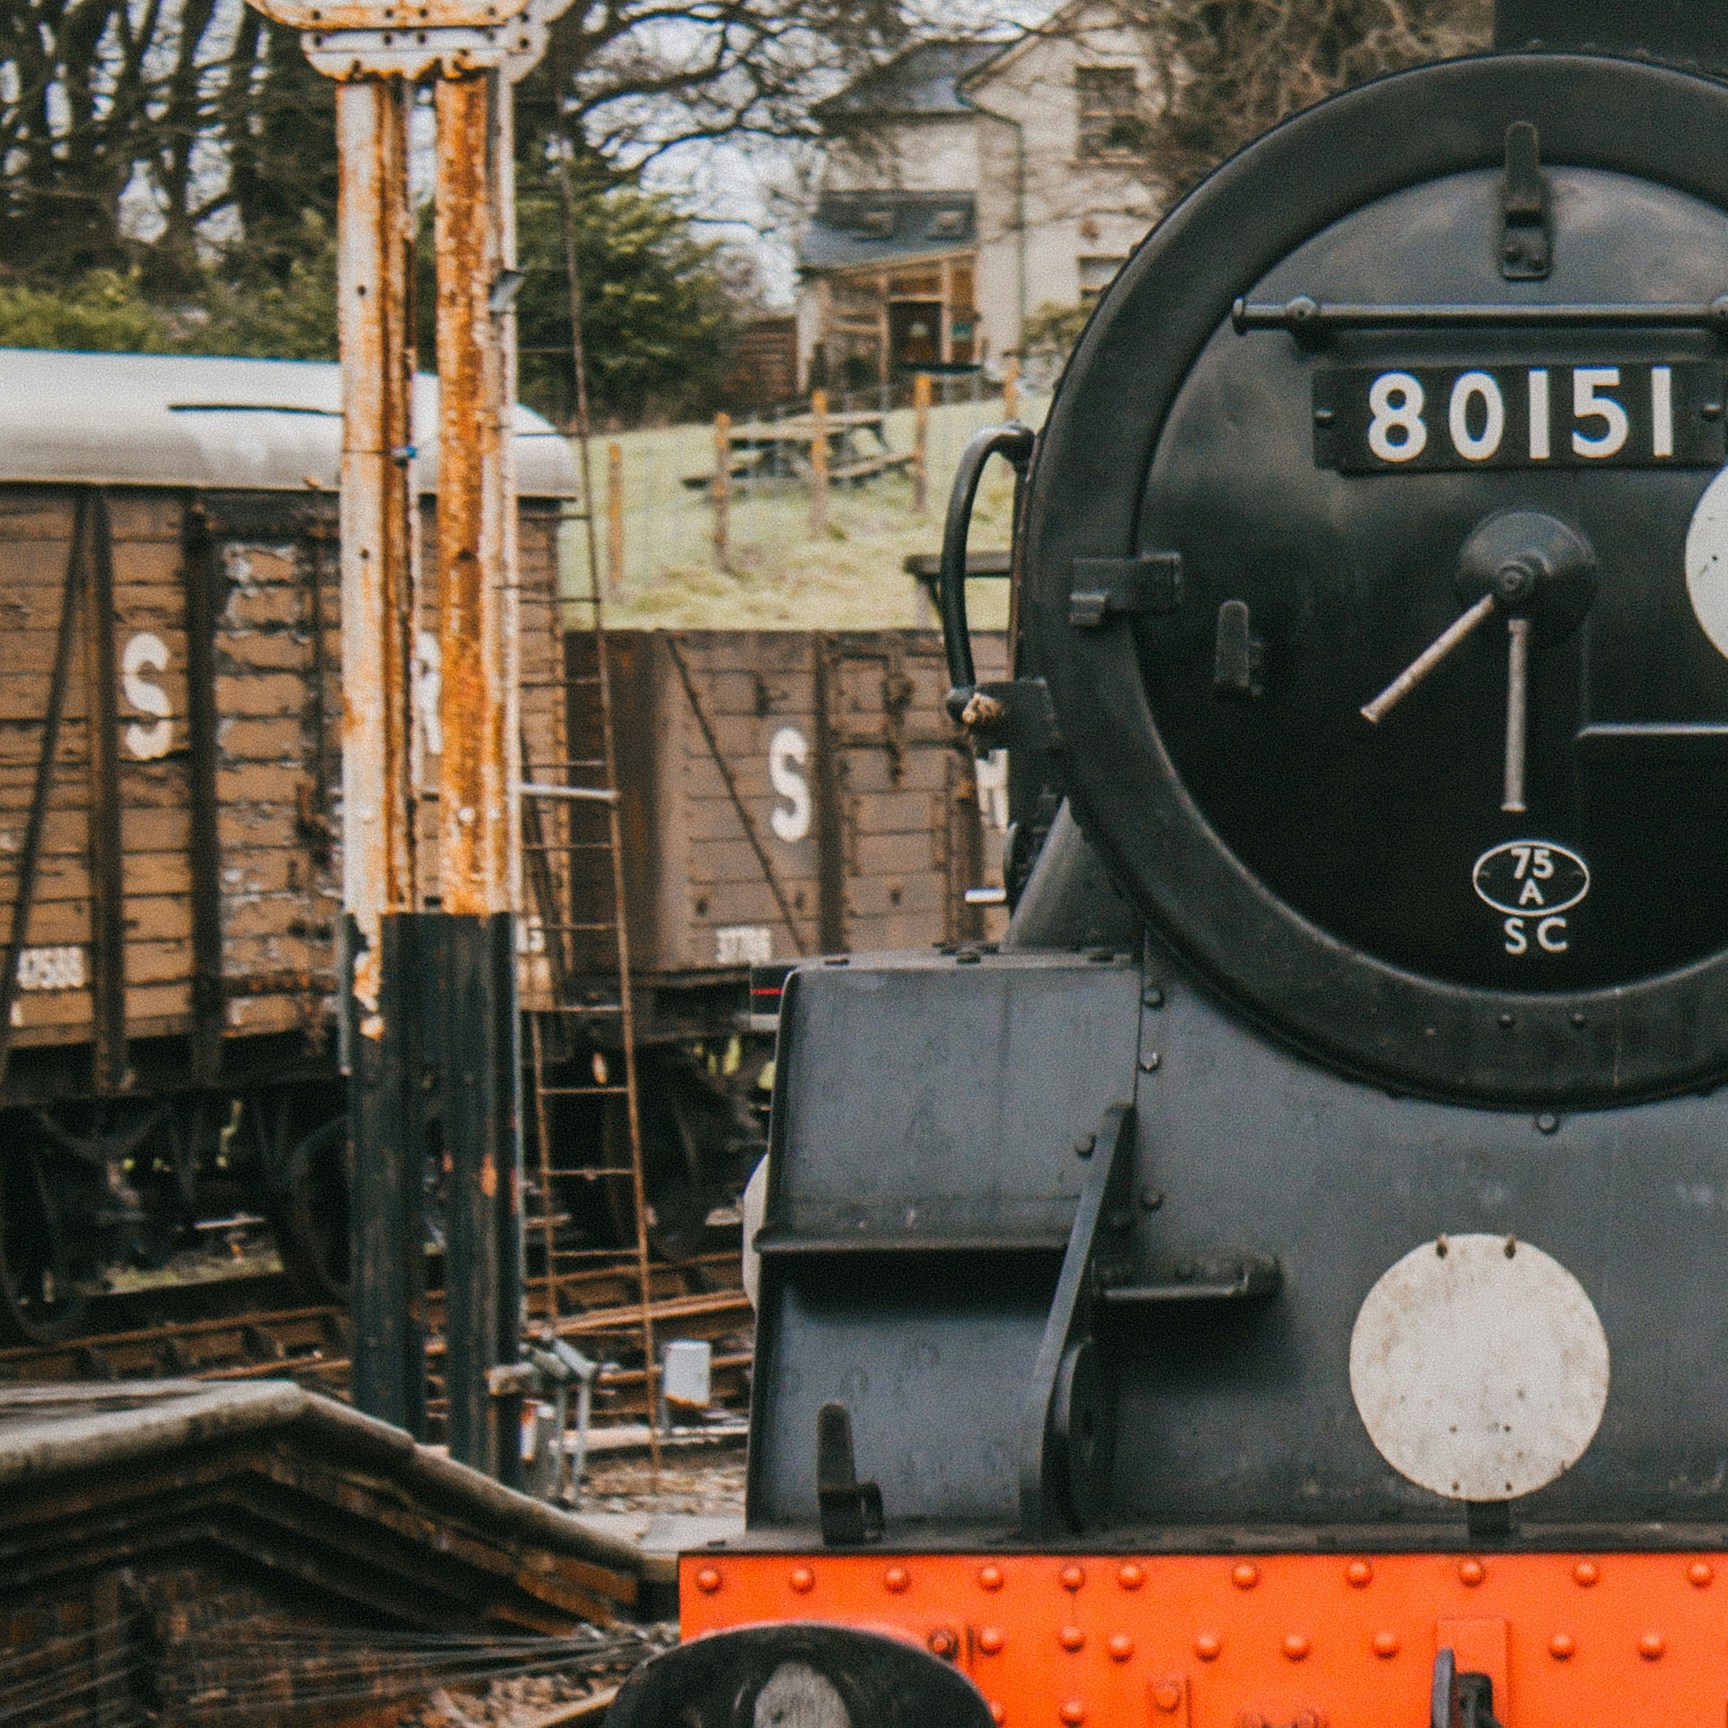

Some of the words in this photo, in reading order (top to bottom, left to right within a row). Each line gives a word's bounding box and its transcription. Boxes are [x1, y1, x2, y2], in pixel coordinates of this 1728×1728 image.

[1368, 367, 1673, 462] 80151
[123, 632, 172, 760] S
[770, 728, 811, 842] S
[1510, 847, 1554, 879] 75
[1518, 878, 1545, 905] A
[1504, 917, 1569, 955] SC
